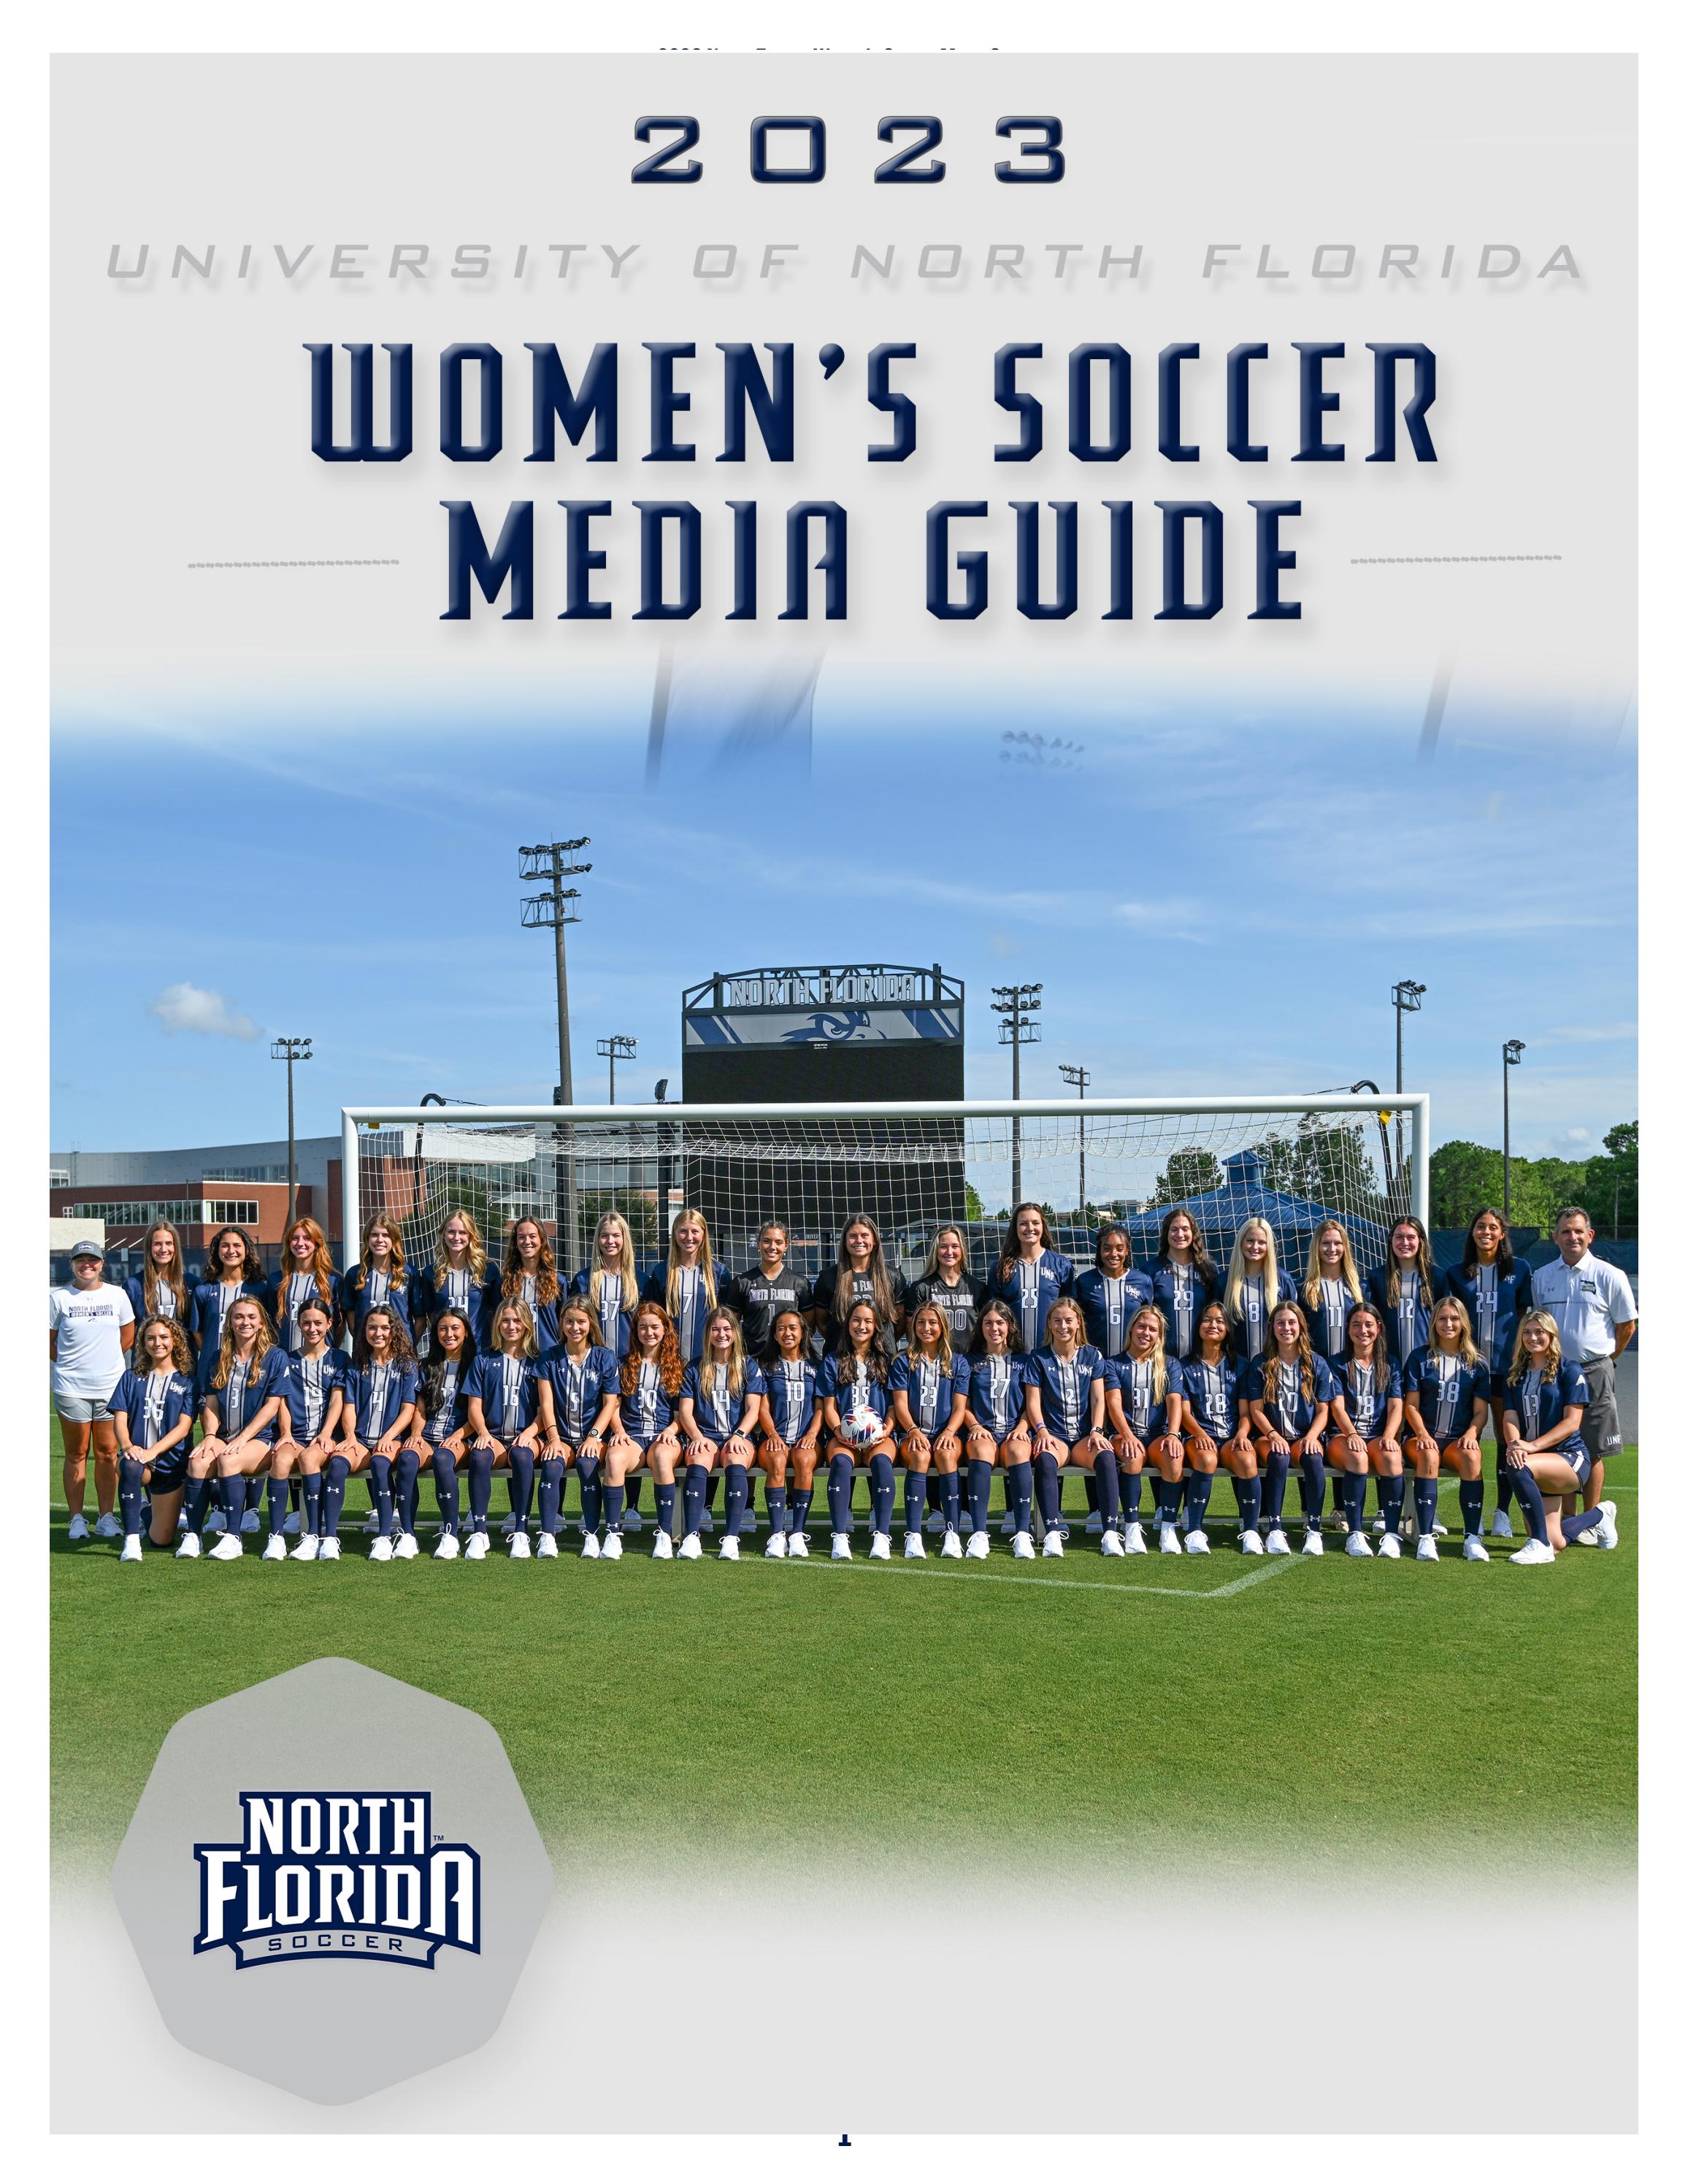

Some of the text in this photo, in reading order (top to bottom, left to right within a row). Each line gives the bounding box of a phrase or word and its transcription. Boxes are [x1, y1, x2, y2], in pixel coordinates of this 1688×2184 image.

[729, 974, 916, 1007] NORTH FLORIDA
[683, 1293, 693, 1313] 7
[749, 1288, 796, 1302] NORTH FLORIDA
[1021, 1288, 1038, 1309] 25
[1173, 1290, 1194, 1310] 29
[1476, 1291, 1497, 1312] 24
[158, 1304, 175, 1319] 17
[601, 1300, 621, 1321] 37
[768, 1304, 775, 1326] 1
[1109, 1304, 1121, 1325] 6
[1248, 1301, 1259, 1323] 8
[1329, 1307, 1343, 1327] 11
[1399, 1298, 1414, 1318] 12
[323, 1365, 336, 1377] UN
[805, 1366, 817, 1379] UN
[1012, 1362, 1025, 1373] UN
[1226, 1371, 1237, 1383] UN
[231, 1388, 239, 1409] 3
[304, 1387, 323, 1406] 19
[502, 1385, 520, 1406] 16
[638, 1388, 657, 1410] 30
[786, 1381, 805, 1402] 10
[852, 1386, 870, 1406] 35
[920, 1385, 937, 1407] 23
[990, 1378, 1010, 1399] 27
[1066, 1388, 1075, 1408] 2
[1133, 1388, 1148, 1409] 31
[1437, 1380, 1459, 1403] 38
[143, 1397, 165, 1421] 36
[372, 1391, 384, 1412] 4
[570, 1392, 578, 1412] 5
[711, 1390, 730, 1411] 14
[1205, 1393, 1227, 1415] 28
[1278, 1392, 1298, 1413] 20
[1356, 1395, 1375, 1415] 18
[1524, 1395, 1538, 1416] 13
[1606, 1435, 1622, 1445] UNF
